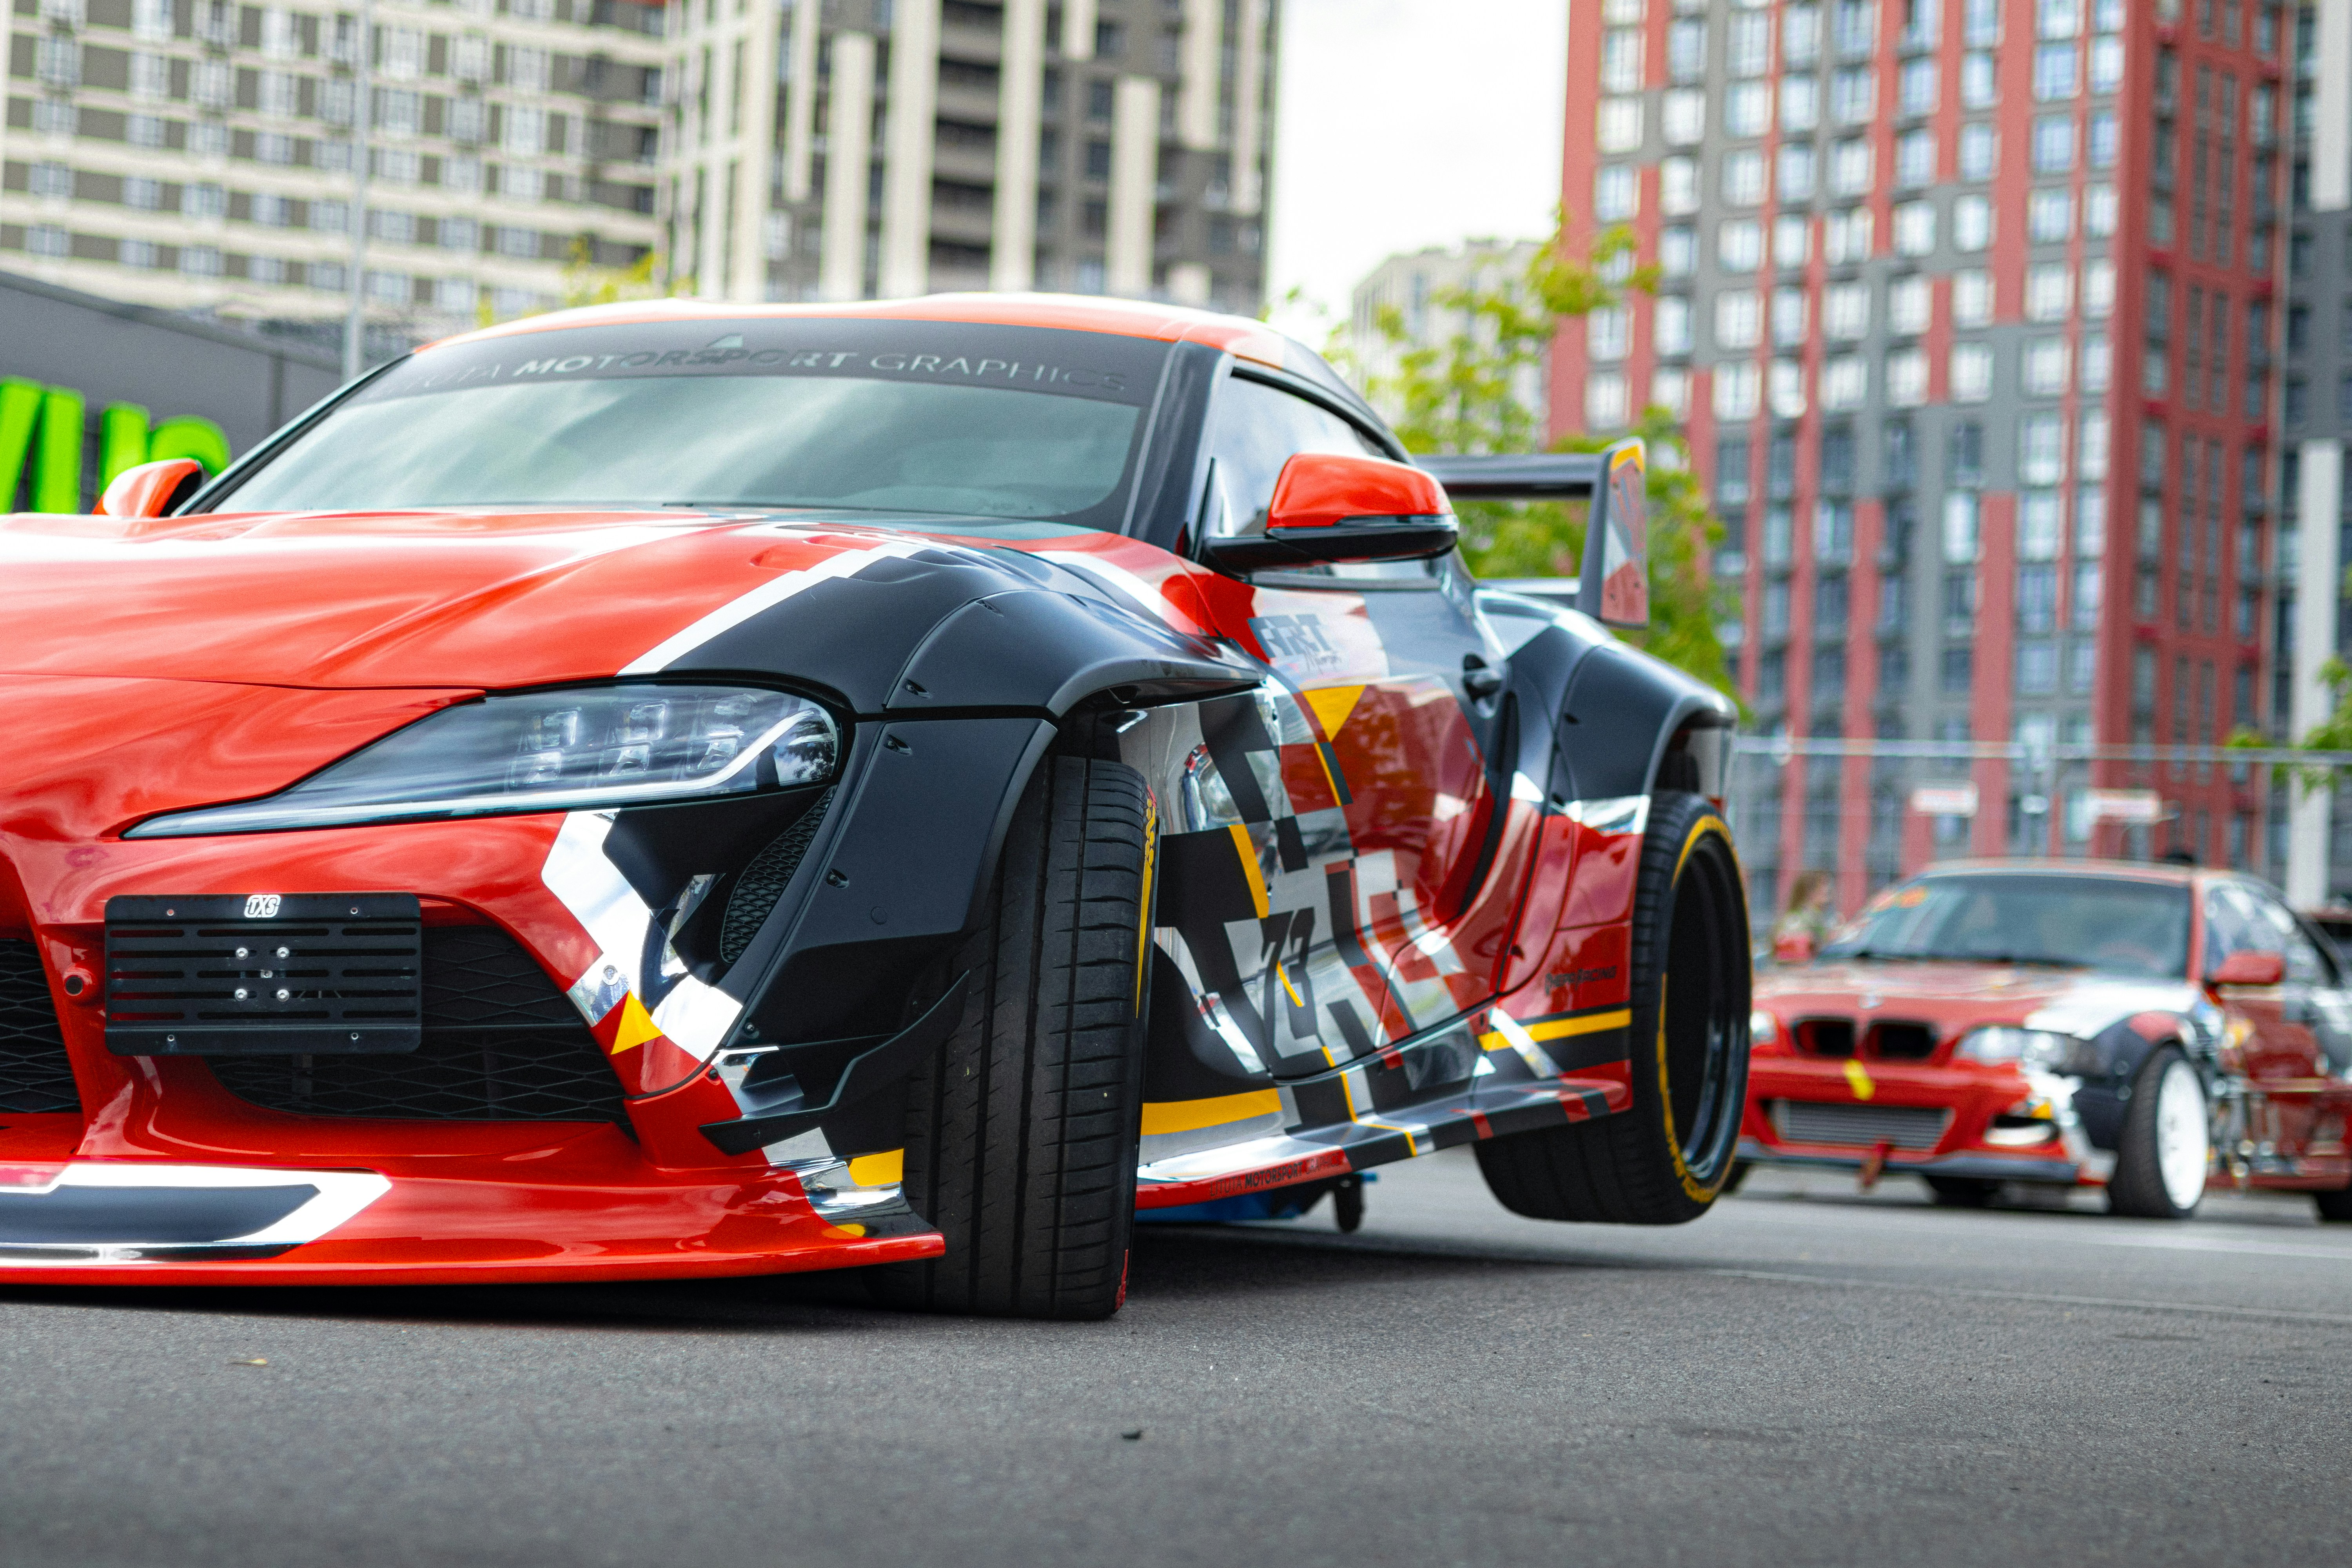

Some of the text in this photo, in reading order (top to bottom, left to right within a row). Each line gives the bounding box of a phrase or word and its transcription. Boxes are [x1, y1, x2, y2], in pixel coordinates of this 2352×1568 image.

[512, 348, 860, 377] MOTORSPORT
[869, 354, 1126, 391] GRAPHICS
[1245, 1162, 1303, 1188] MOTORSPORT
